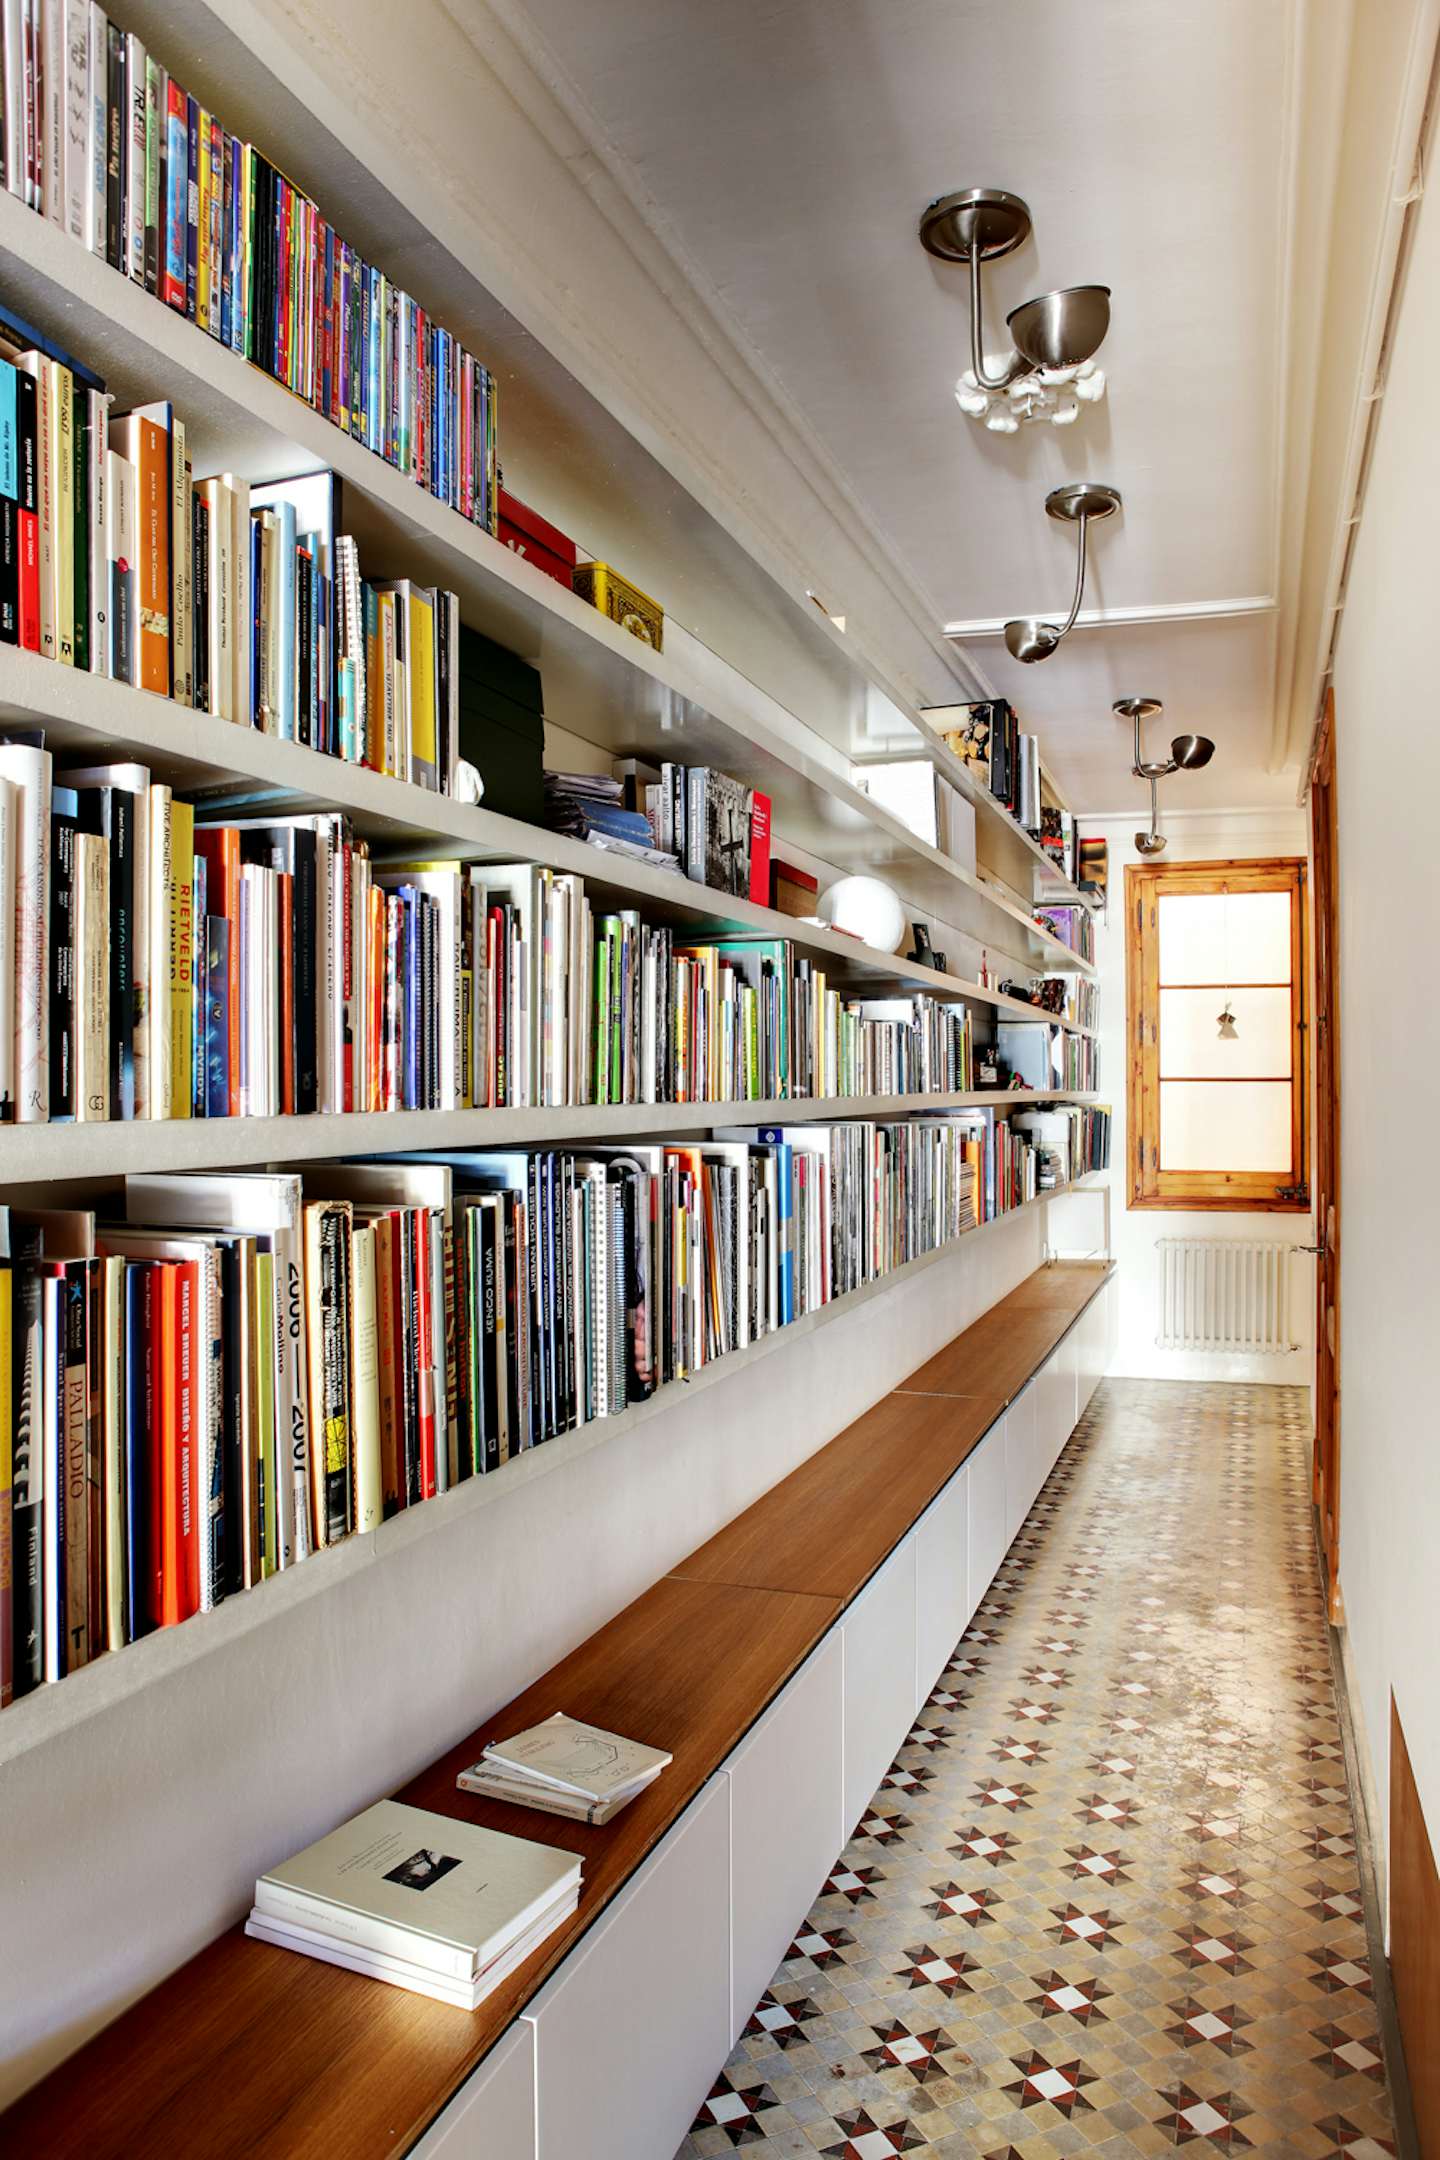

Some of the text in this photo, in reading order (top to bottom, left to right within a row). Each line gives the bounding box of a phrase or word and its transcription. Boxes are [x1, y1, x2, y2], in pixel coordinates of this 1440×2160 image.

[176, 435, 185, 507] El Alquimista
[176, 574, 184, 646] Paulo Coelho
[163, 802, 171, 891] FIVE ARCHITECTS
[118, 909, 127, 992] encounters
[179, 884, 191, 981] RIETVELD
[182, 1280, 190, 1330] MARCEL
[486, 1288, 494, 1334] KENGO
[182, 1333, 190, 1381] BREUER
[288, 1262, 306, 1473] 2006 2007
[69, 1381, 85, 1499] PALLADIO
[182, 1387, 191, 1433] DISEÑO
[181, 1446, 190, 1536] ARQUITECTURA
[28, 1526, 38, 1586] Finland
